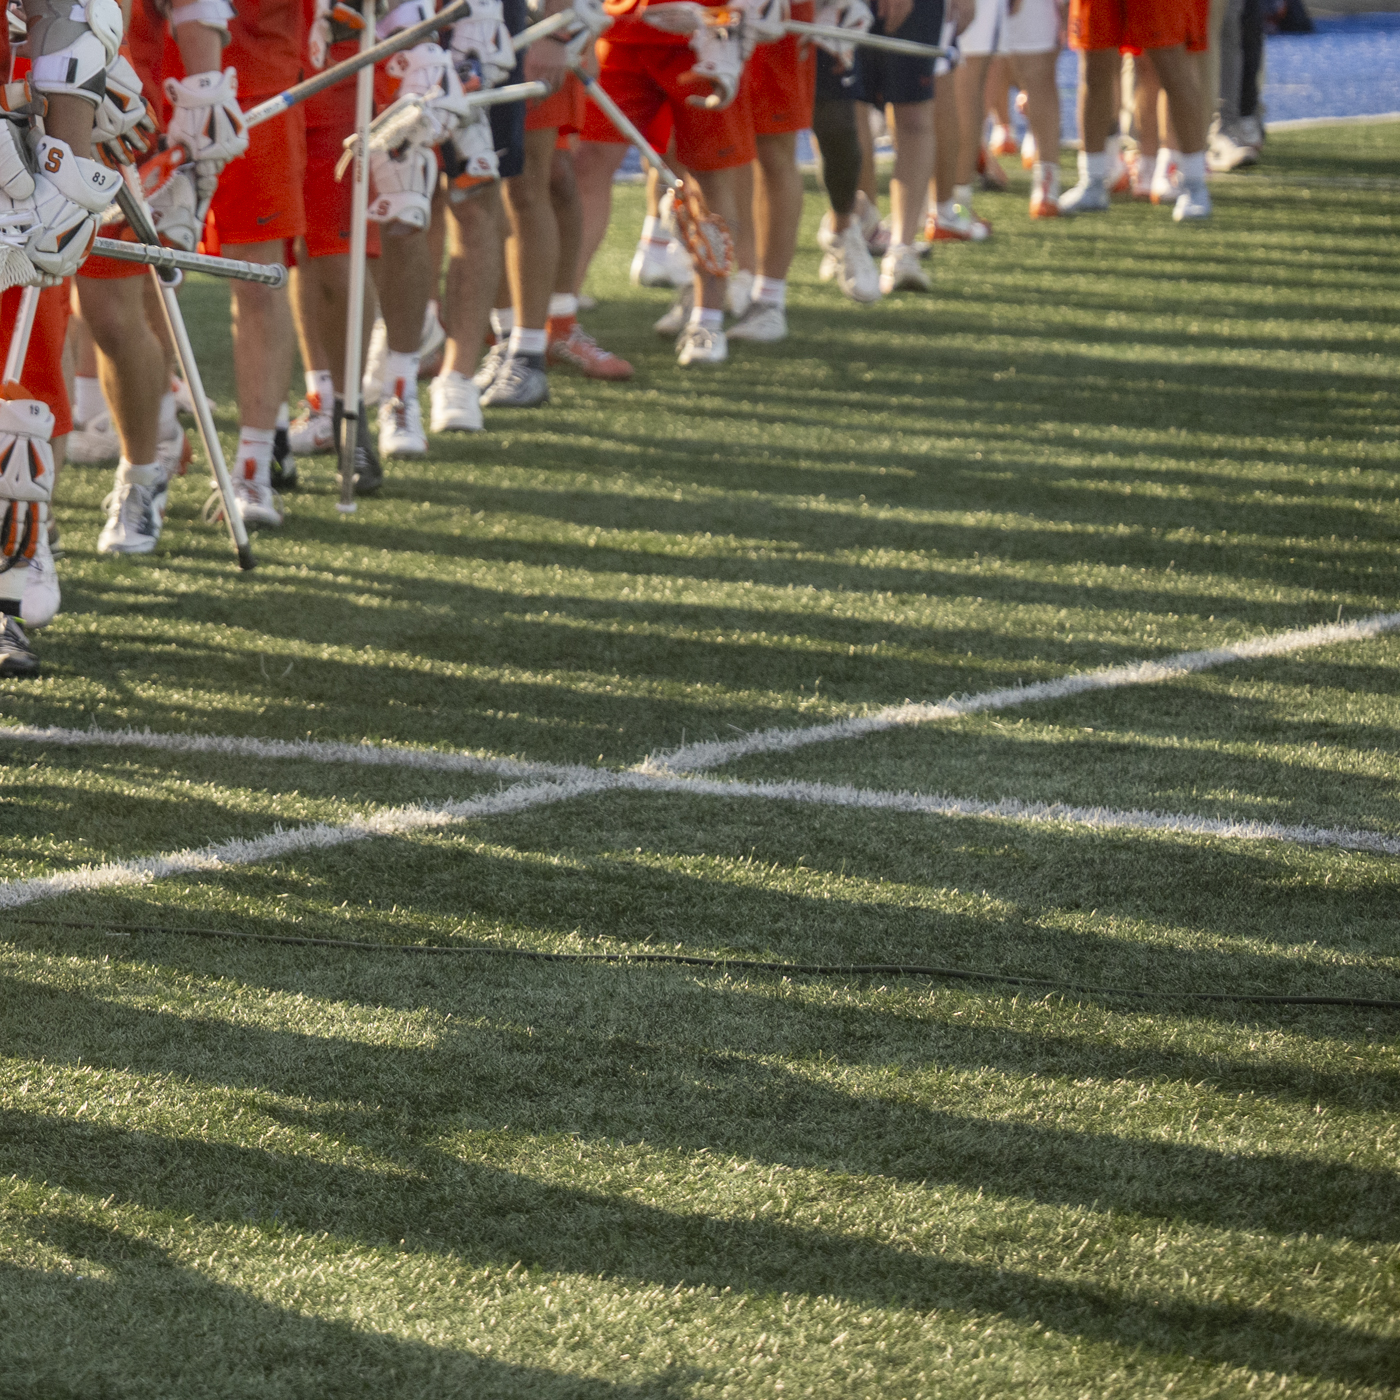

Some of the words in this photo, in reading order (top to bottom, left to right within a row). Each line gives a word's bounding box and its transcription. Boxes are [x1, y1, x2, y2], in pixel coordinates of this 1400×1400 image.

[44, 146, 64, 174] S
[91, 171, 106, 186] 83
[29, 404, 40, 416] 19
